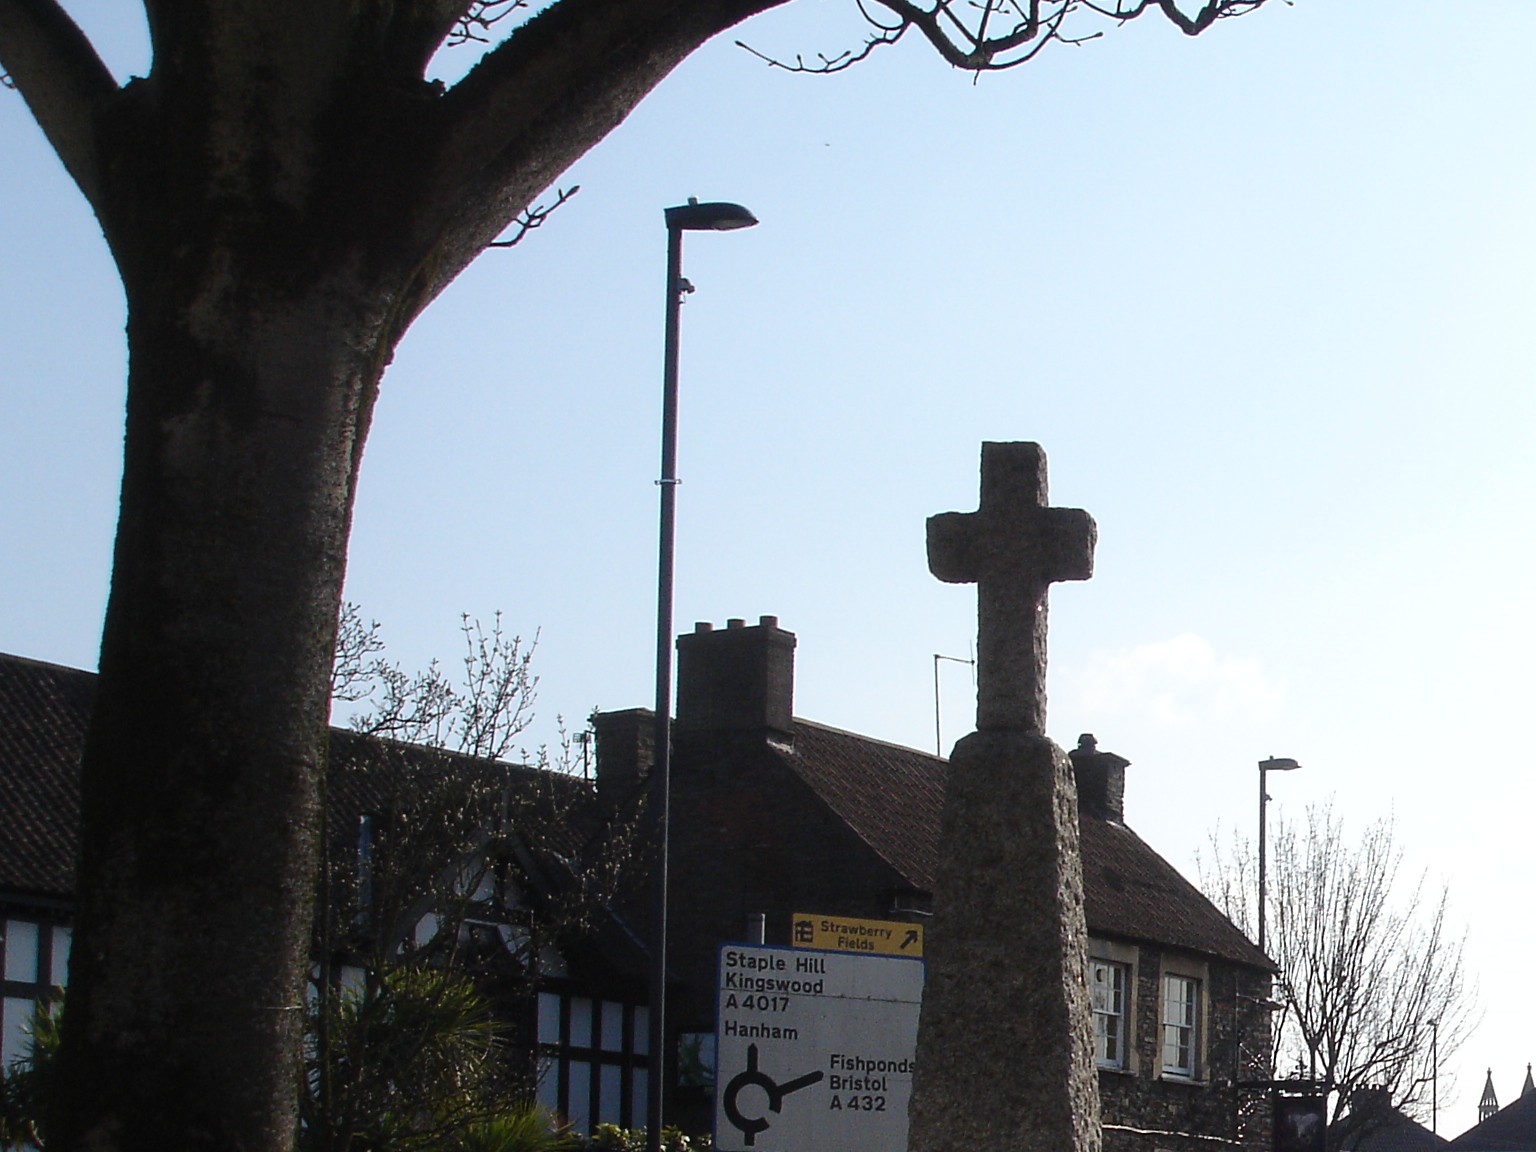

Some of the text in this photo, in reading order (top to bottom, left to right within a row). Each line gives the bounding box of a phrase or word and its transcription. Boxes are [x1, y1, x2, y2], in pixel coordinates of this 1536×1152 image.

[820, 920, 893, 940] Strawberry
[837, 936, 875, 951] Fields
[726, 951, 826, 974] Staple Hill
[725, 972, 823, 994] Kingswood
[725, 1020, 798, 1040] Hanham
[830, 1054, 916, 1075] Fishponds
[829, 1074, 887, 1092] Bristol
